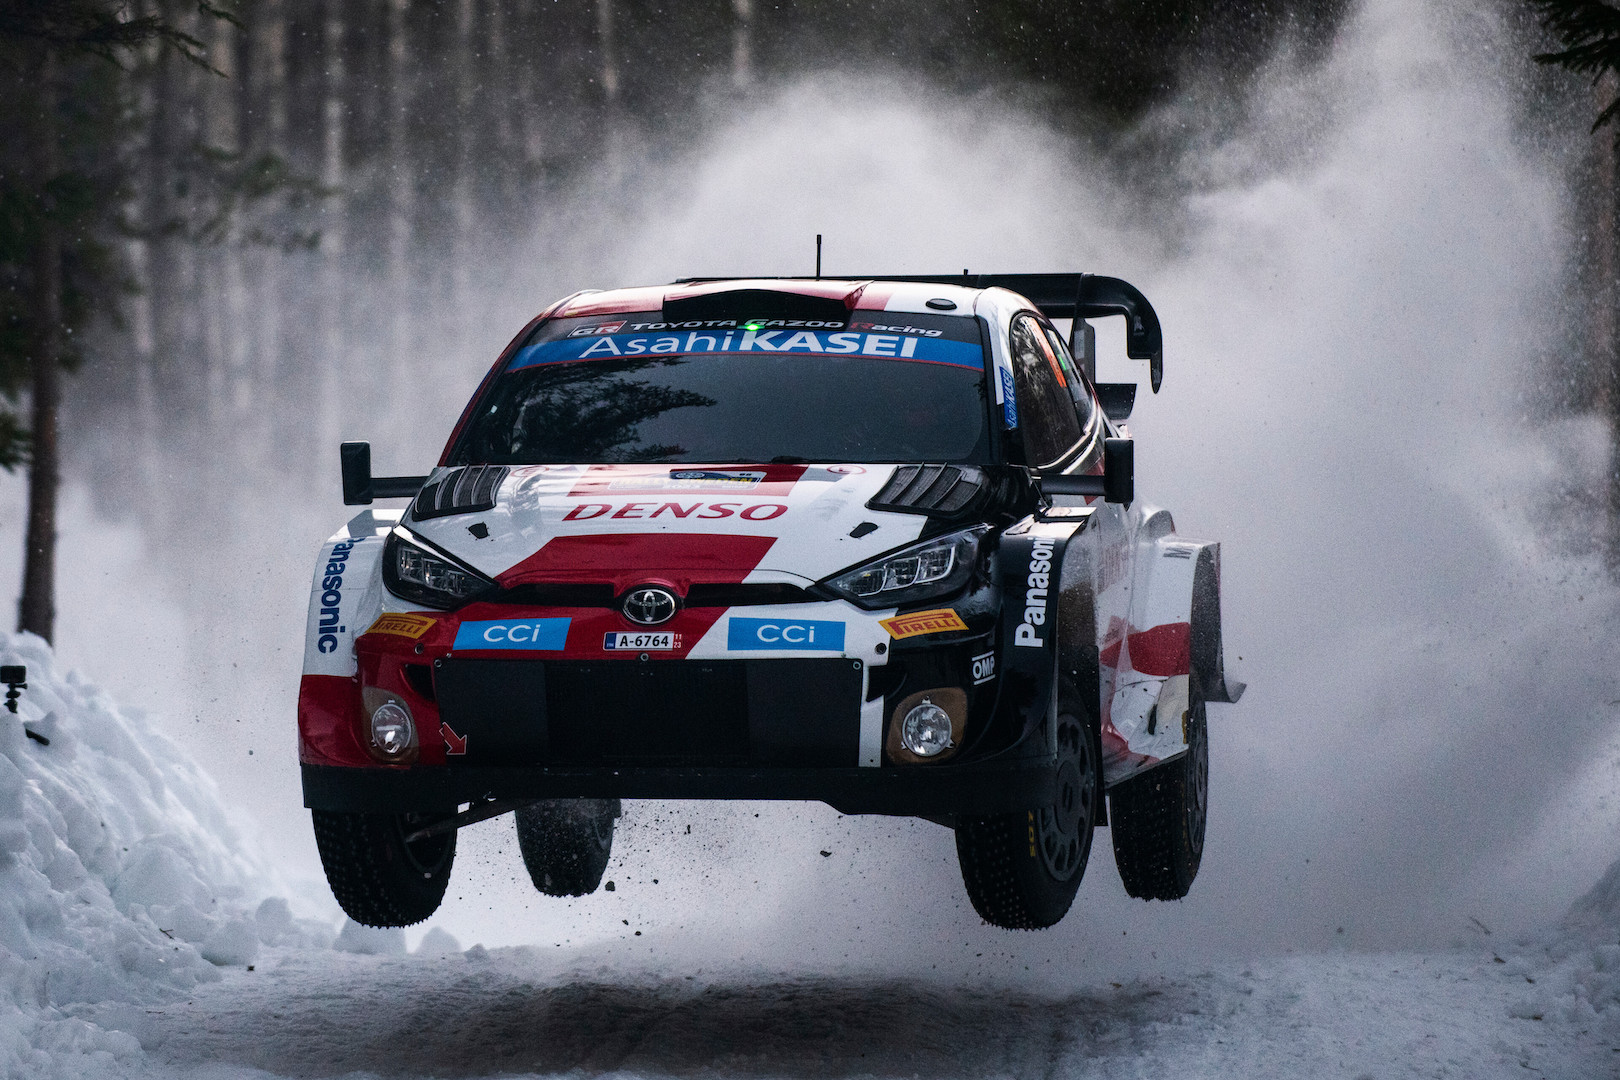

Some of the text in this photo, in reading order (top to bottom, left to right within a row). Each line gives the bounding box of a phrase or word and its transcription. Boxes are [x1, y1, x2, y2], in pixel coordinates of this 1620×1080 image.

[571, 324, 620, 336] GR
[631, 318, 943, 337] TOYOTA GAZOO Racing
[562, 502, 789, 521] DENSO
[1014, 537, 1055, 648] Panasoni
[372, 615, 429, 634] PIRELLI
[888, 612, 960, 635] PIRELLI
[619, 635, 669, 647] A-6764
[972, 656, 995, 680] OMP
